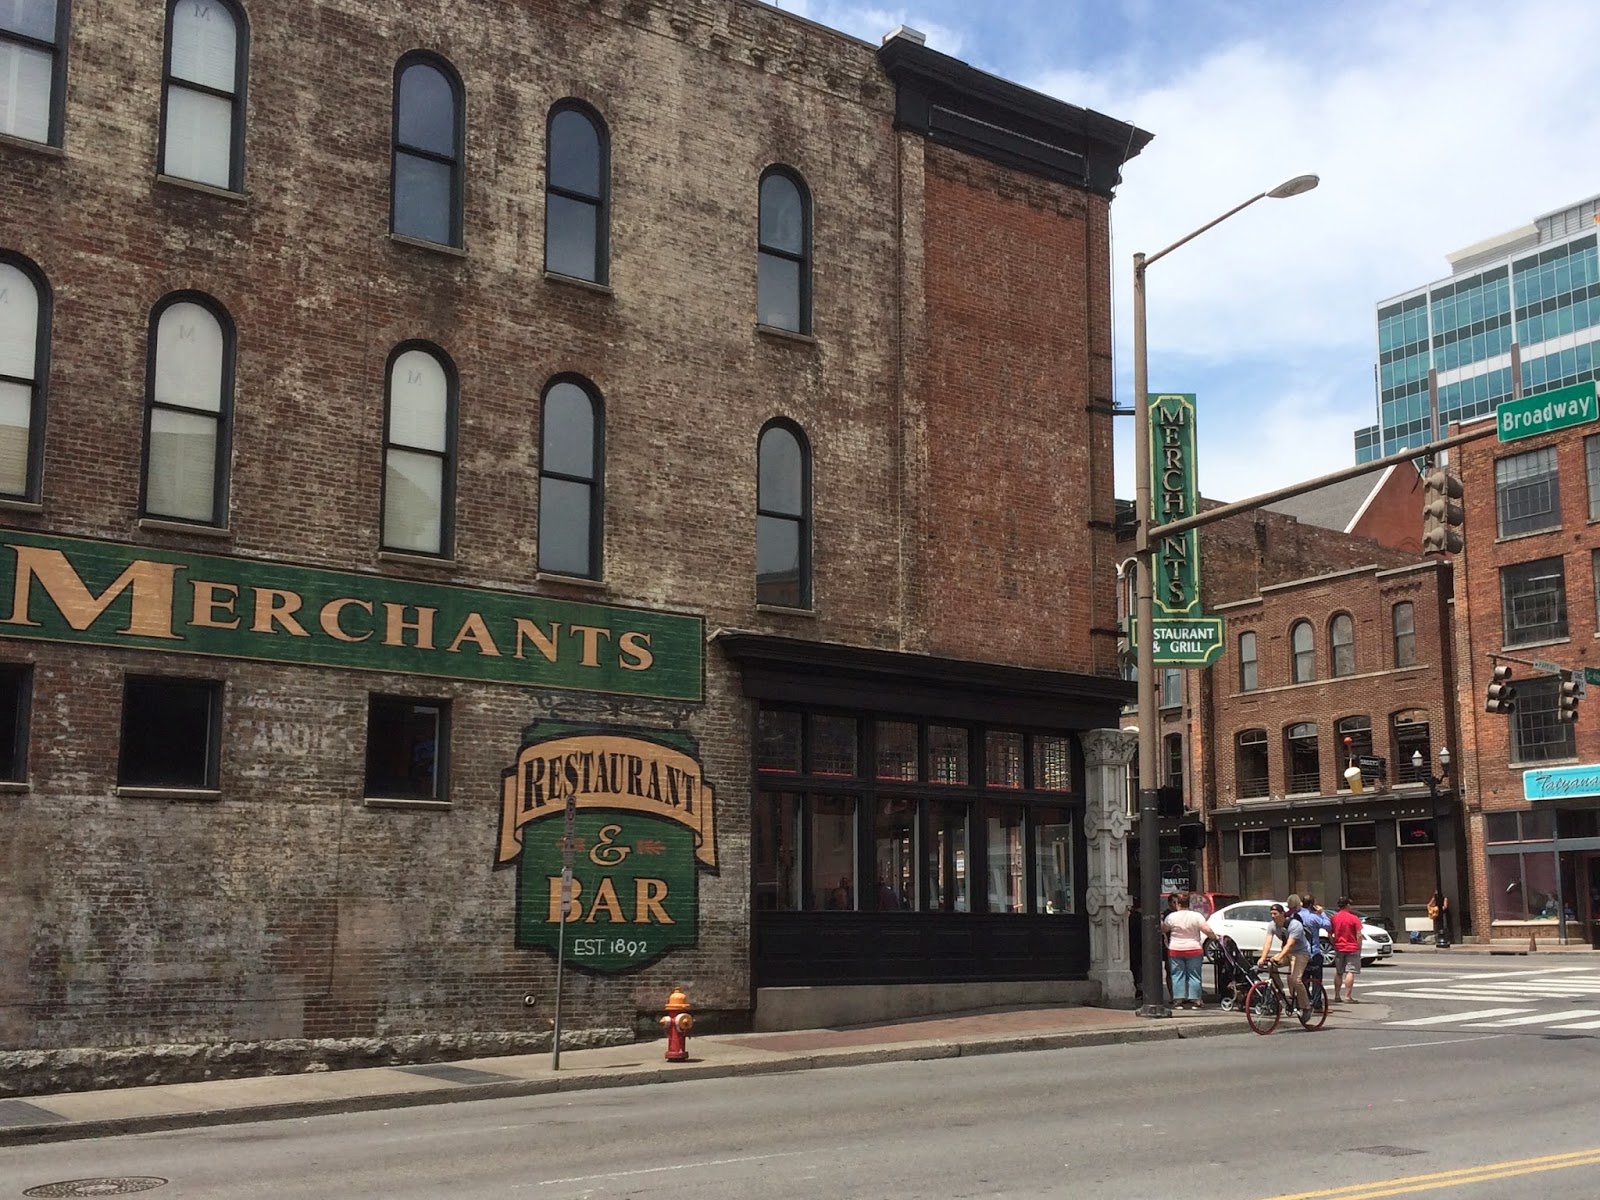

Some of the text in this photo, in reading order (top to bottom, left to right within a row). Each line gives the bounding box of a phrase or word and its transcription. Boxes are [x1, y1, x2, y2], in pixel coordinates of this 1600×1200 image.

[1503, 396, 1592, 432] Broadway
[3, 544, 654, 671] MERCHANTS
[1152, 628, 1215, 640] STAURANT
[1170, 641, 1204, 653] GRILL
[522, 749, 696, 816] RESTAURANT
[589, 823, 632, 867] &
[546, 875, 676, 925] BAR
[573, 938, 648, 958] EST. 1892
